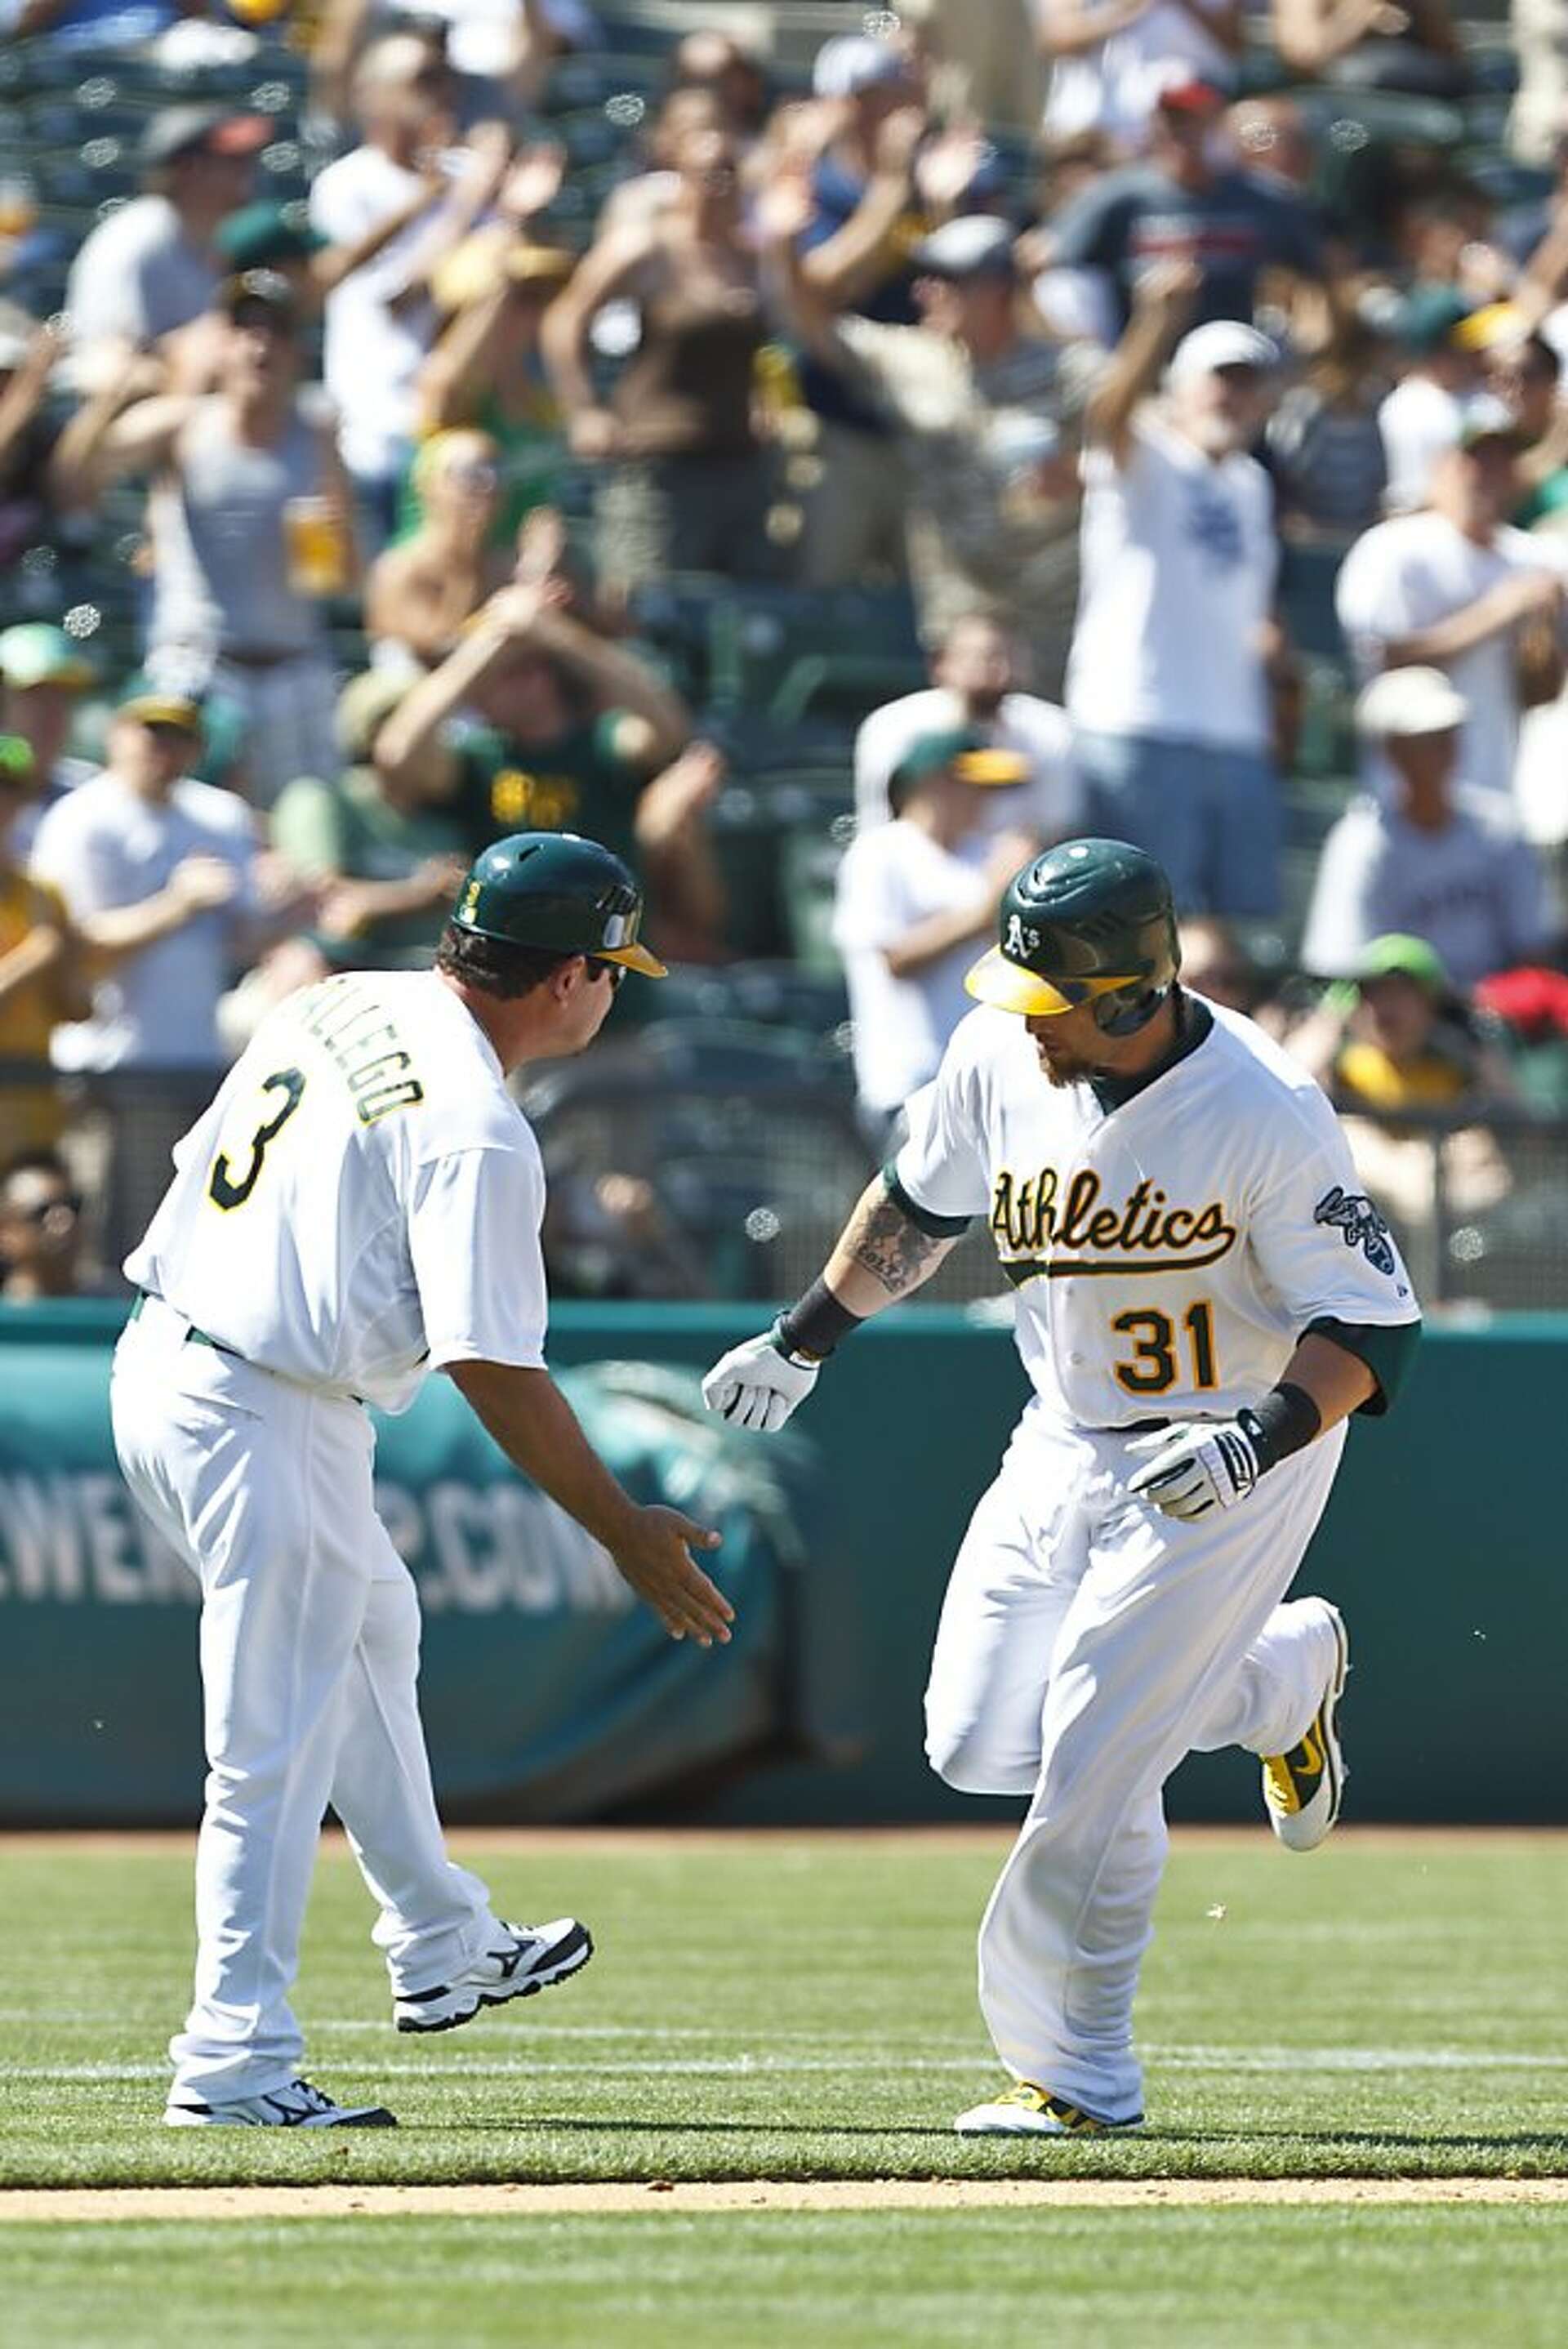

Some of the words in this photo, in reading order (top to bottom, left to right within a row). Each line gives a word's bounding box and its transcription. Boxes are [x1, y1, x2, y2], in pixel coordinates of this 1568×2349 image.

[1004, 914, 1040, 959] A's
[208, 1066, 308, 1214] 3
[991, 1166, 1236, 1258] Athletics
[1111, 1300, 1219, 1395] 31
